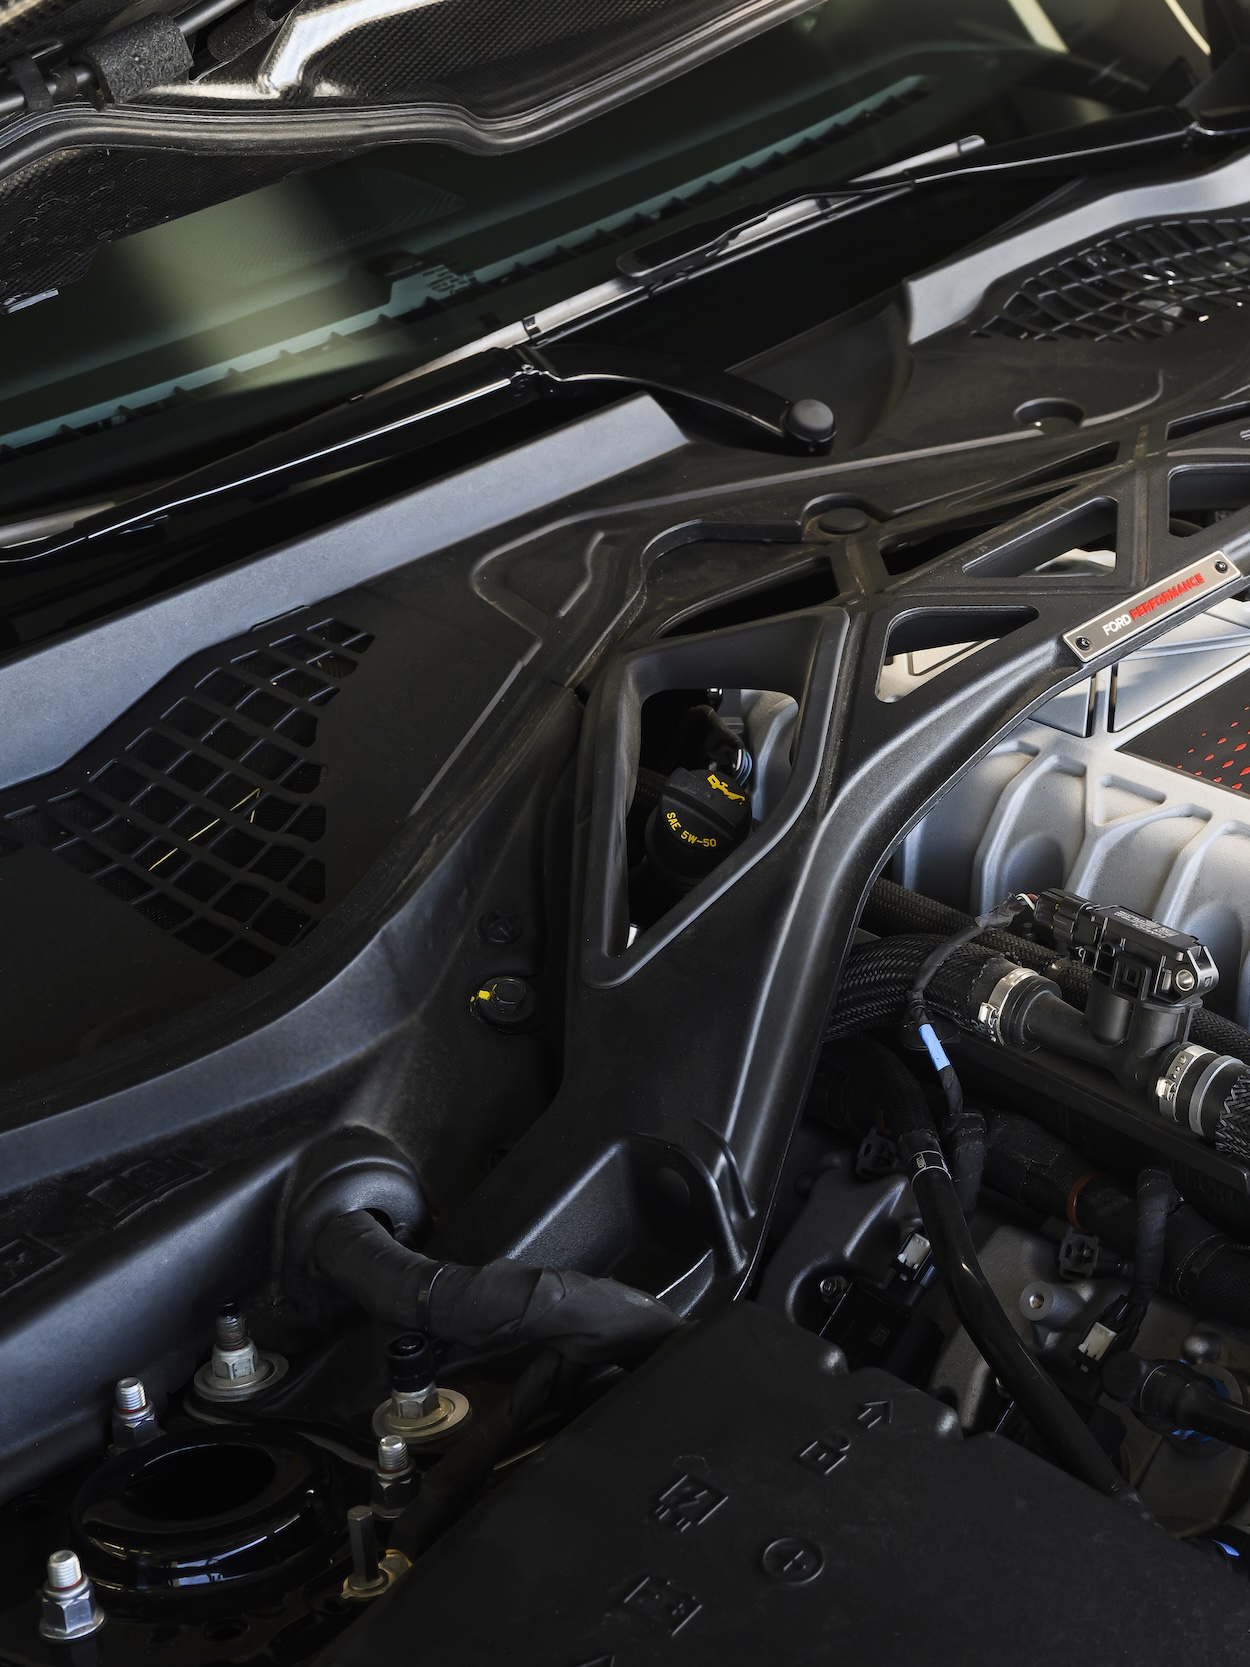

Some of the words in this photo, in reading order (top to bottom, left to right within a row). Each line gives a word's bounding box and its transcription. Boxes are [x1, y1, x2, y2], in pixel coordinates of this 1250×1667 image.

[1102, 613, 1132, 636] FORD
[1129, 573, 1205, 621] PERFORMANCE
[666, 812, 682, 831] SAE
[680, 830, 717, 847] 5W-50
